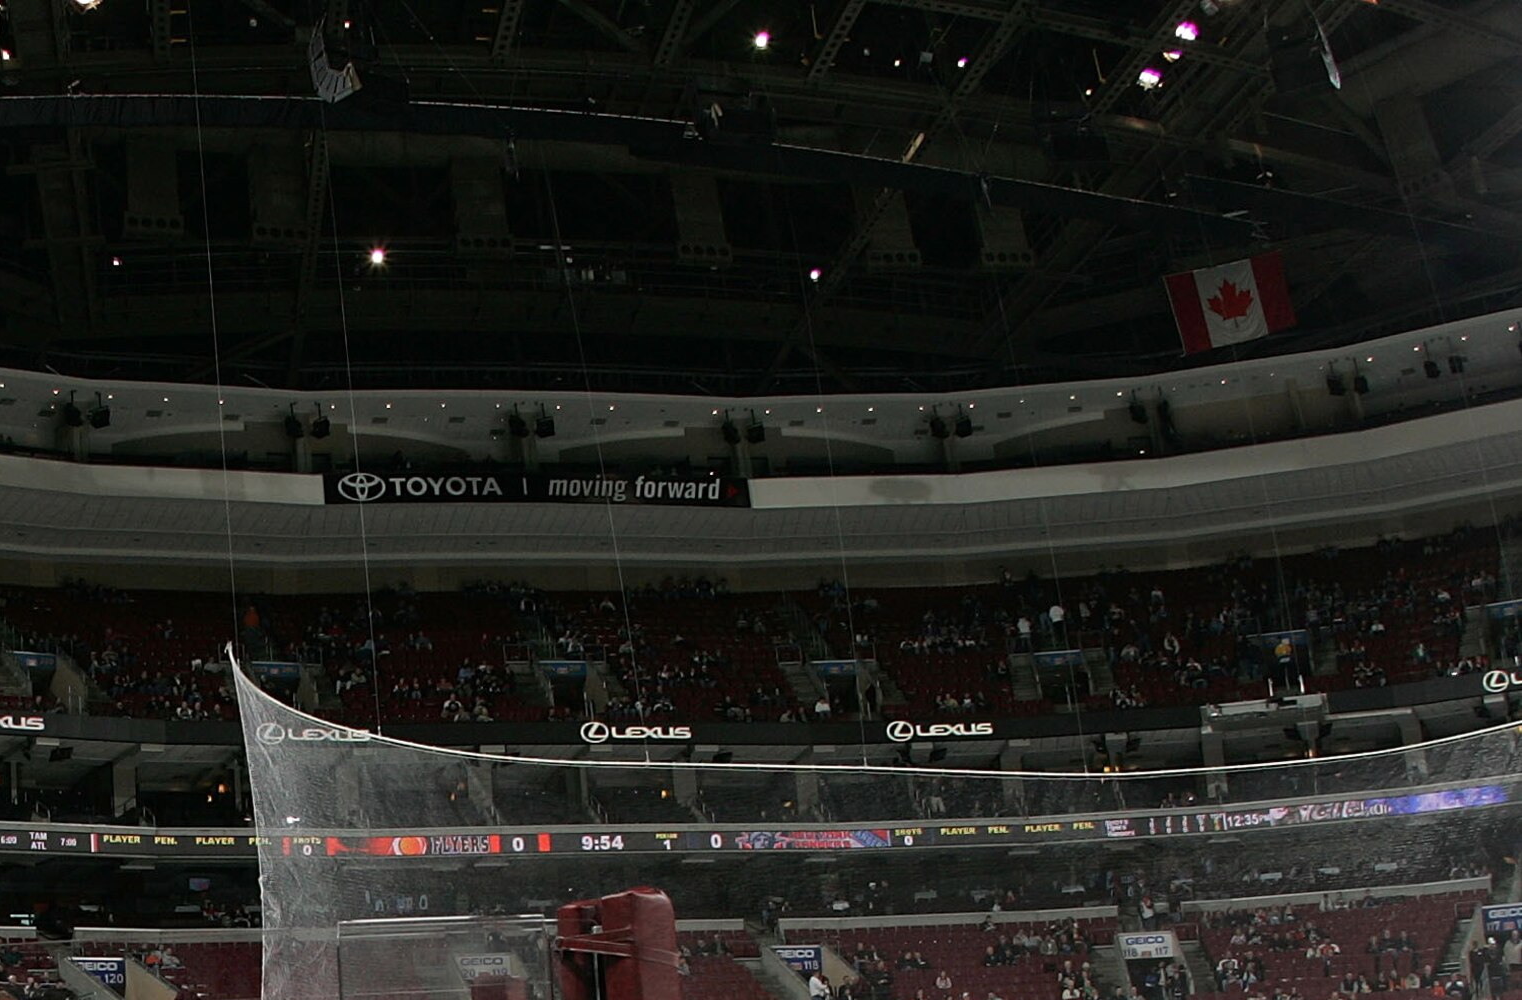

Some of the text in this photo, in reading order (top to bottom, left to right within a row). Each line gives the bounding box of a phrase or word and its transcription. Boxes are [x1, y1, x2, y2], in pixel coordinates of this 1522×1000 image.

[389, 477, 503, 496] TOYOTA
[548, 474, 721, 502] moving forward
[287, 728, 370, 742] LEXUS
[610, 726, 692, 739] LEXUS
[916, 722, 994, 737] LEXUS
[940, 827, 976, 836] PLAYER
[1025, 823, 1061, 833] PLAYER
[29, 831, 48, 841] TAM
[103, 834, 178, 846] PLAYER PEN.
[196, 837, 235, 845] PLAYER
[710, 833, 723, 848] 0
[904, 836, 914, 846] 0
[31, 841, 47, 851] ATL
[430, 836, 489, 854] FLYERS
[512, 837, 525, 852] 0
[581, 834, 624, 850] 9:54
[663, 840, 672, 851] 1
[1126, 935, 1165, 946] GEICO
[460, 957, 503, 966] GEICO
[104, 974, 125, 985] 120
